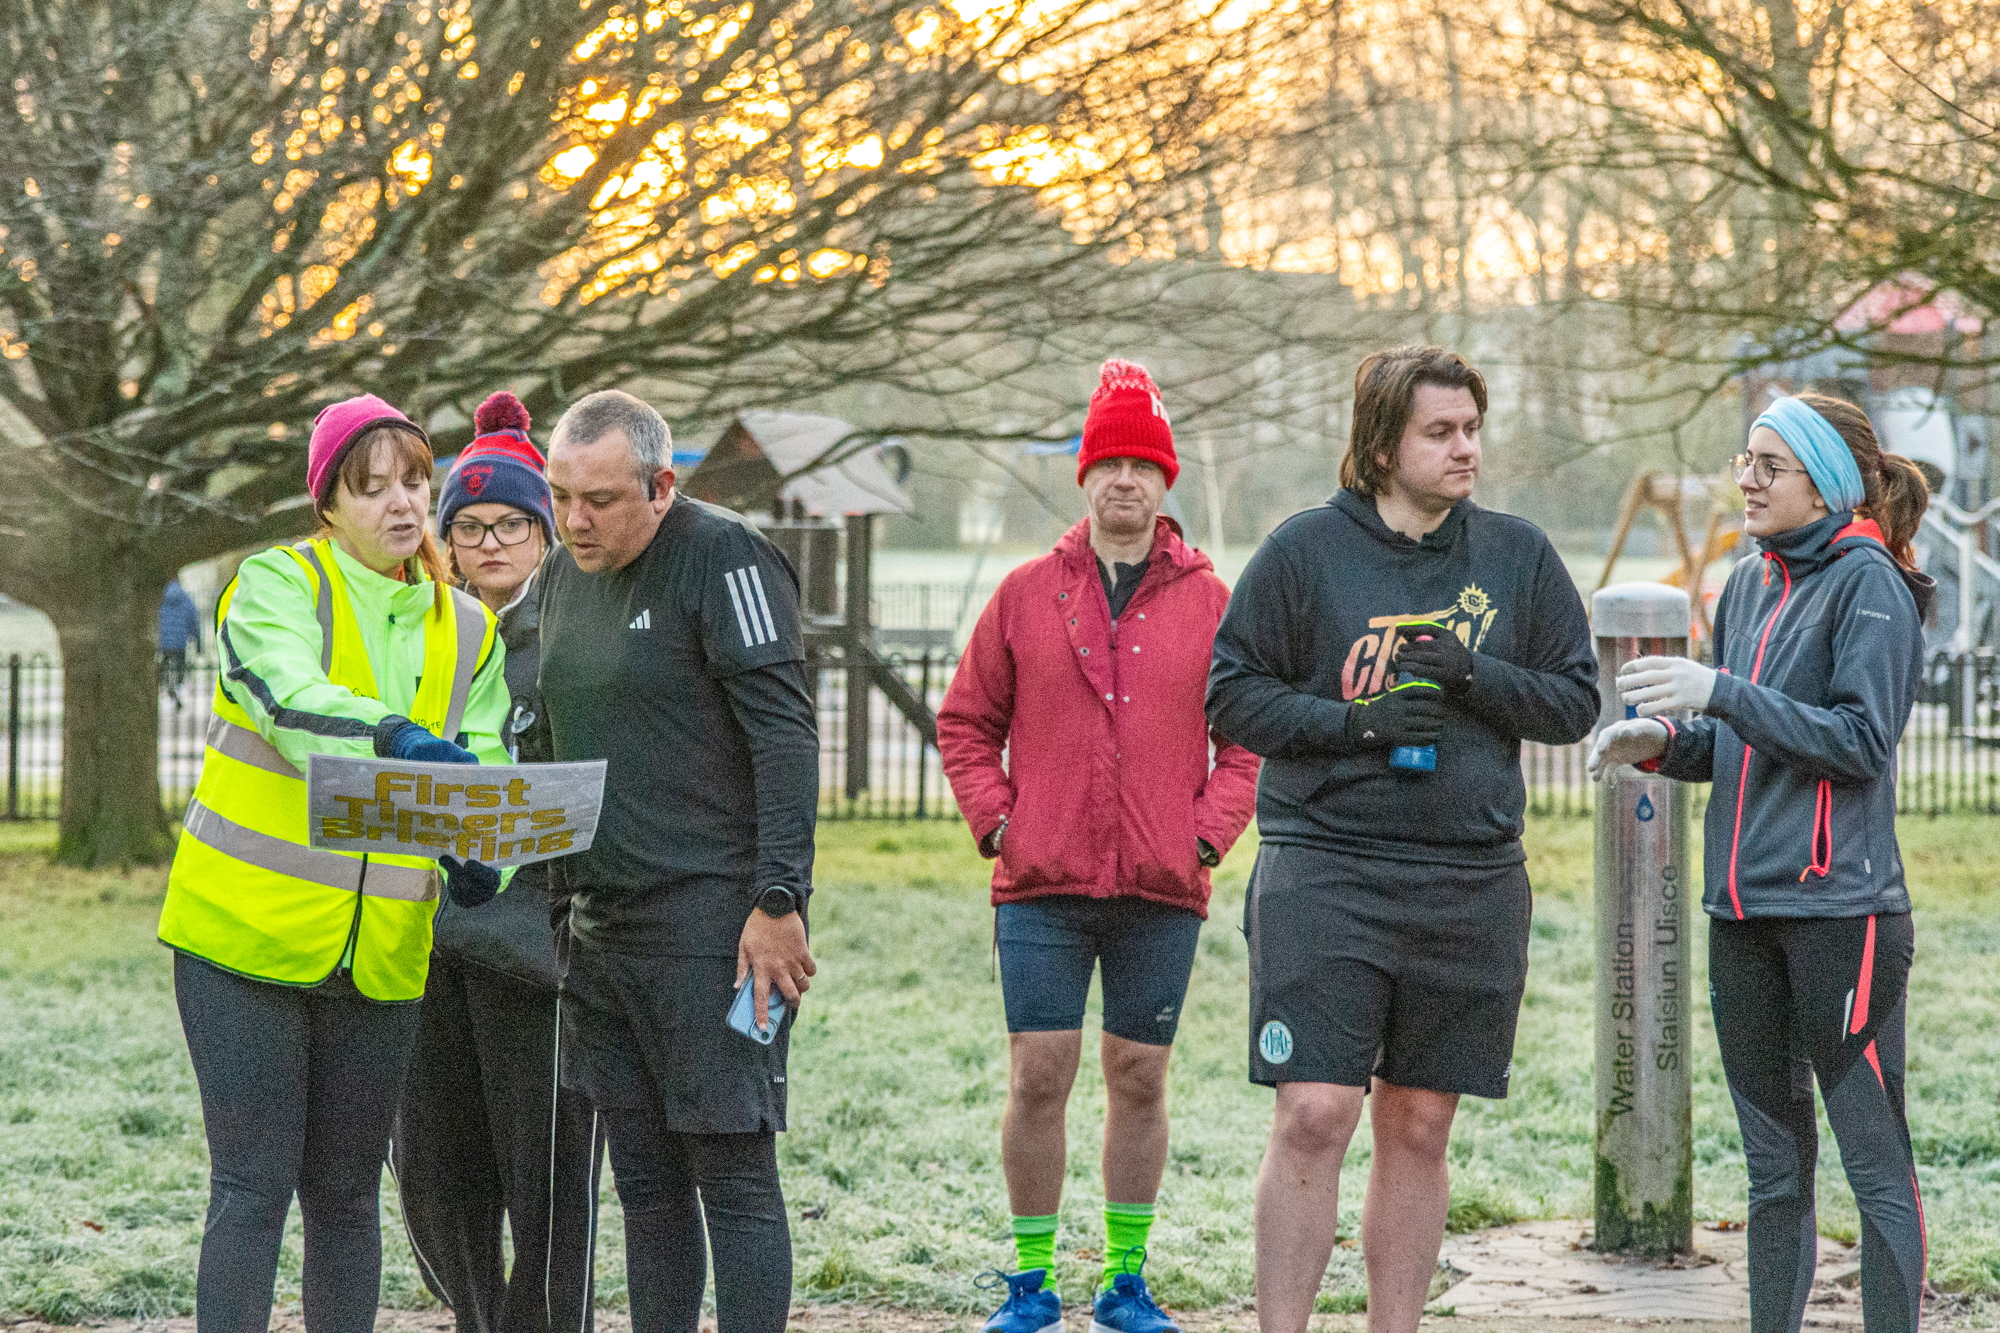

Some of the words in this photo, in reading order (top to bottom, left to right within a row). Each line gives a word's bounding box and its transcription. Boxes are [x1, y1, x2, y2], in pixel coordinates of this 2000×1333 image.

[333, 795, 566, 836] Timers
[374, 771, 532, 808] First
[322, 817, 578, 862] Briefing
[1656, 865, 1678, 946] Uisce
[1611, 922, 1635, 1020] Station
[1656, 960, 1678, 1071] Staisiun
[1611, 1031, 1635, 1117] Water
